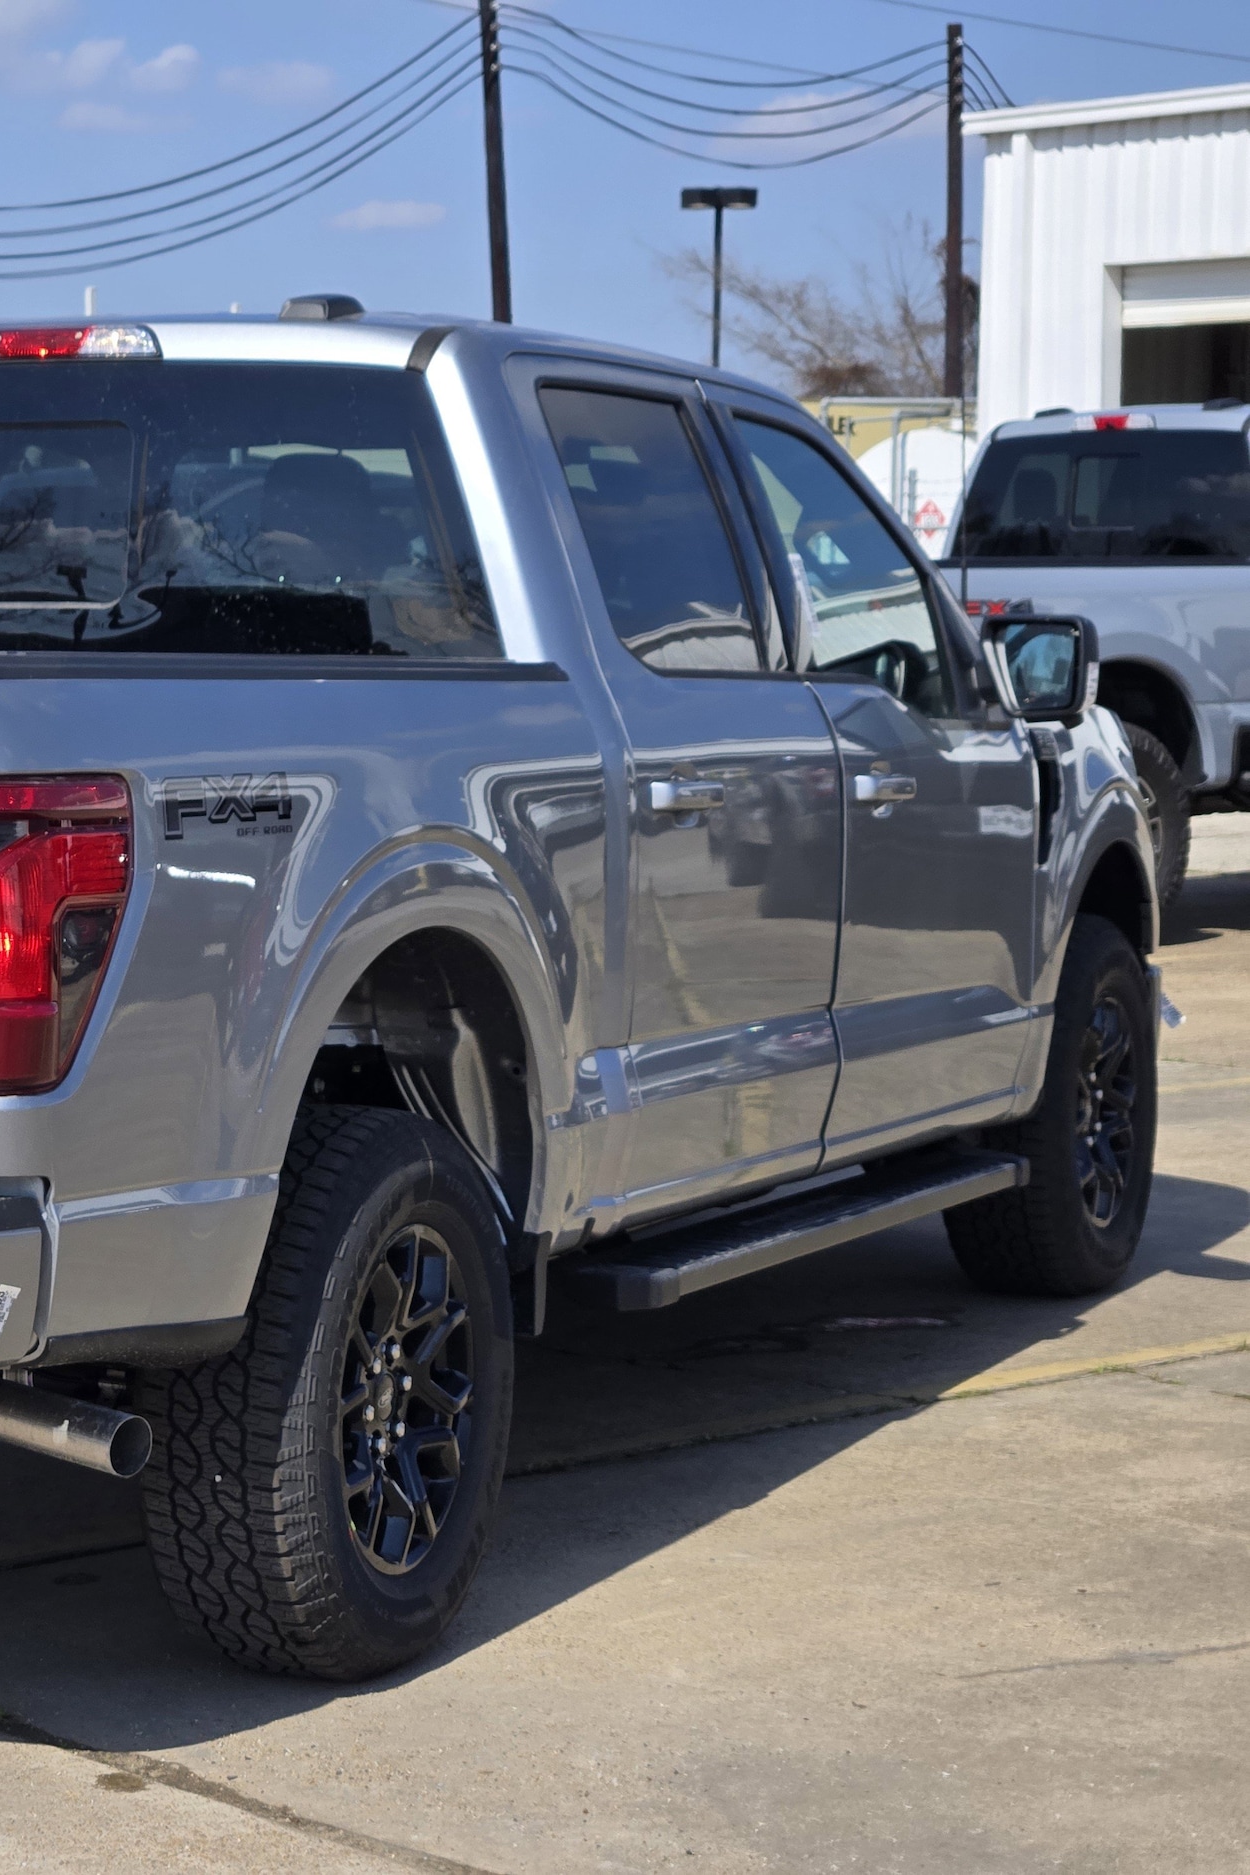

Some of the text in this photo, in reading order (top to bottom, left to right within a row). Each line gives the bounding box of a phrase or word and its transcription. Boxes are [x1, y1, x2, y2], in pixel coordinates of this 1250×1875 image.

[162, 771, 292, 840] FX4
[236, 825, 293, 837] OFF ROAD
